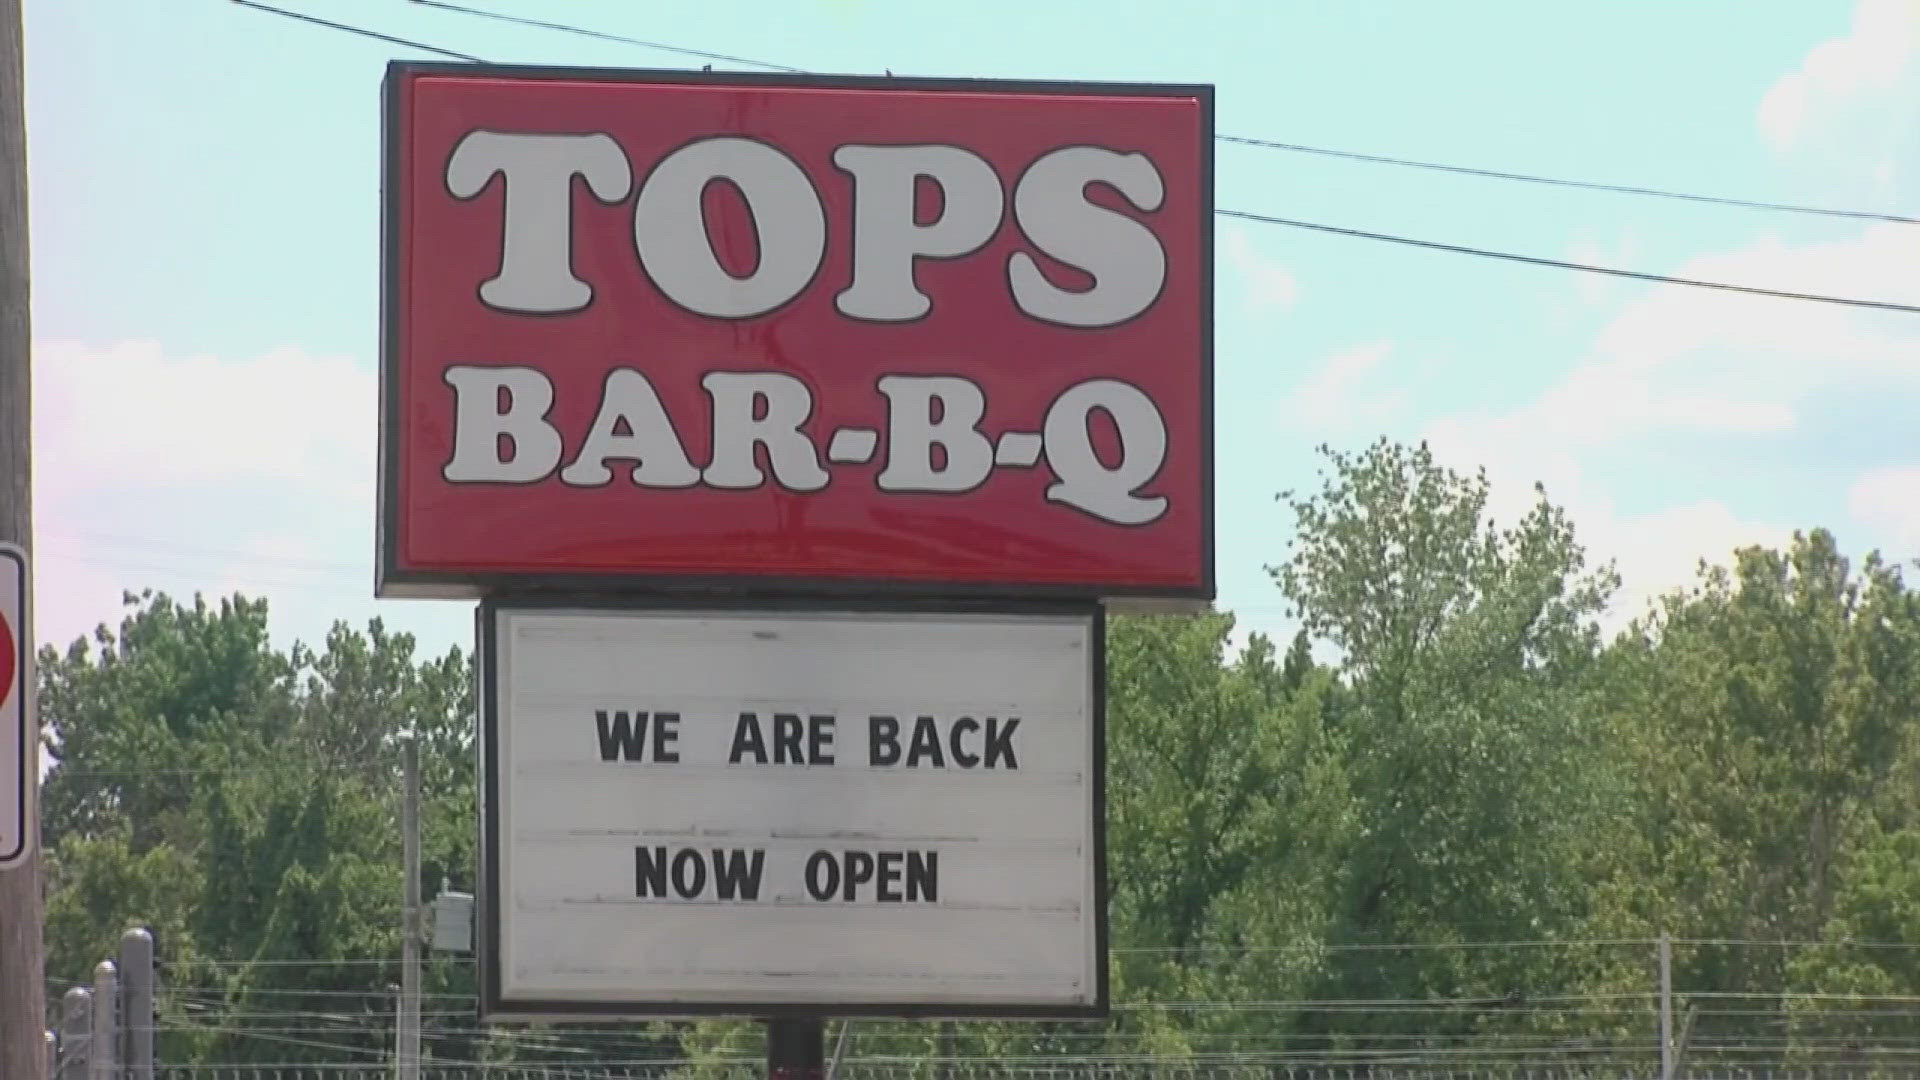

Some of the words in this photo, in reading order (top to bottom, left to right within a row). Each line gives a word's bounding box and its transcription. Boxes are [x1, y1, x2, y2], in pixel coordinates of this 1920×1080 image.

[445, 129, 1166, 328] TOPS
[442, 364, 1169, 525] BAR-B-Q
[595, 709, 681, 764] WE
[729, 711, 836, 767] ARE
[869, 715, 1021, 770] BACK
[634, 845, 766, 902] NOW
[804, 848, 939, 904] OPEN
